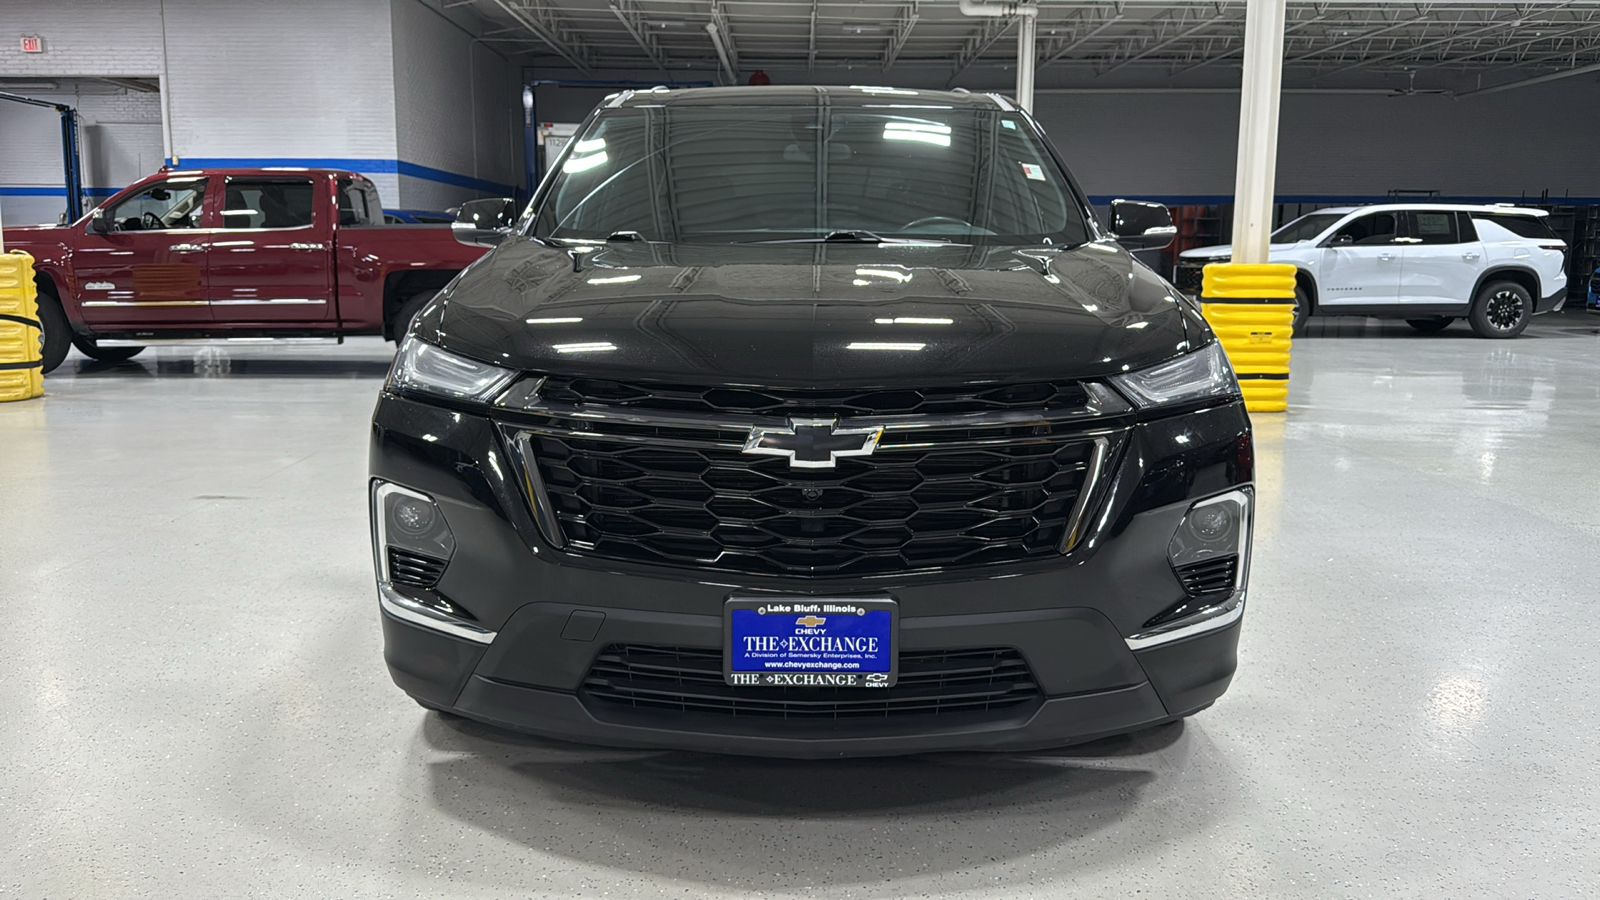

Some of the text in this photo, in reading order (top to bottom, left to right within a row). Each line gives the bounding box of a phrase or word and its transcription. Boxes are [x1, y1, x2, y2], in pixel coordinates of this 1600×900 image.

[23, 38, 38, 50] EXIT
[767, 604, 857, 613] Lake Bluff, Illinois
[743, 636, 879, 653] THE EXCHANGE
[764, 661, 860, 670] www.chevyexchange.com
[730, 673, 857, 686] THE EXCHANGE
